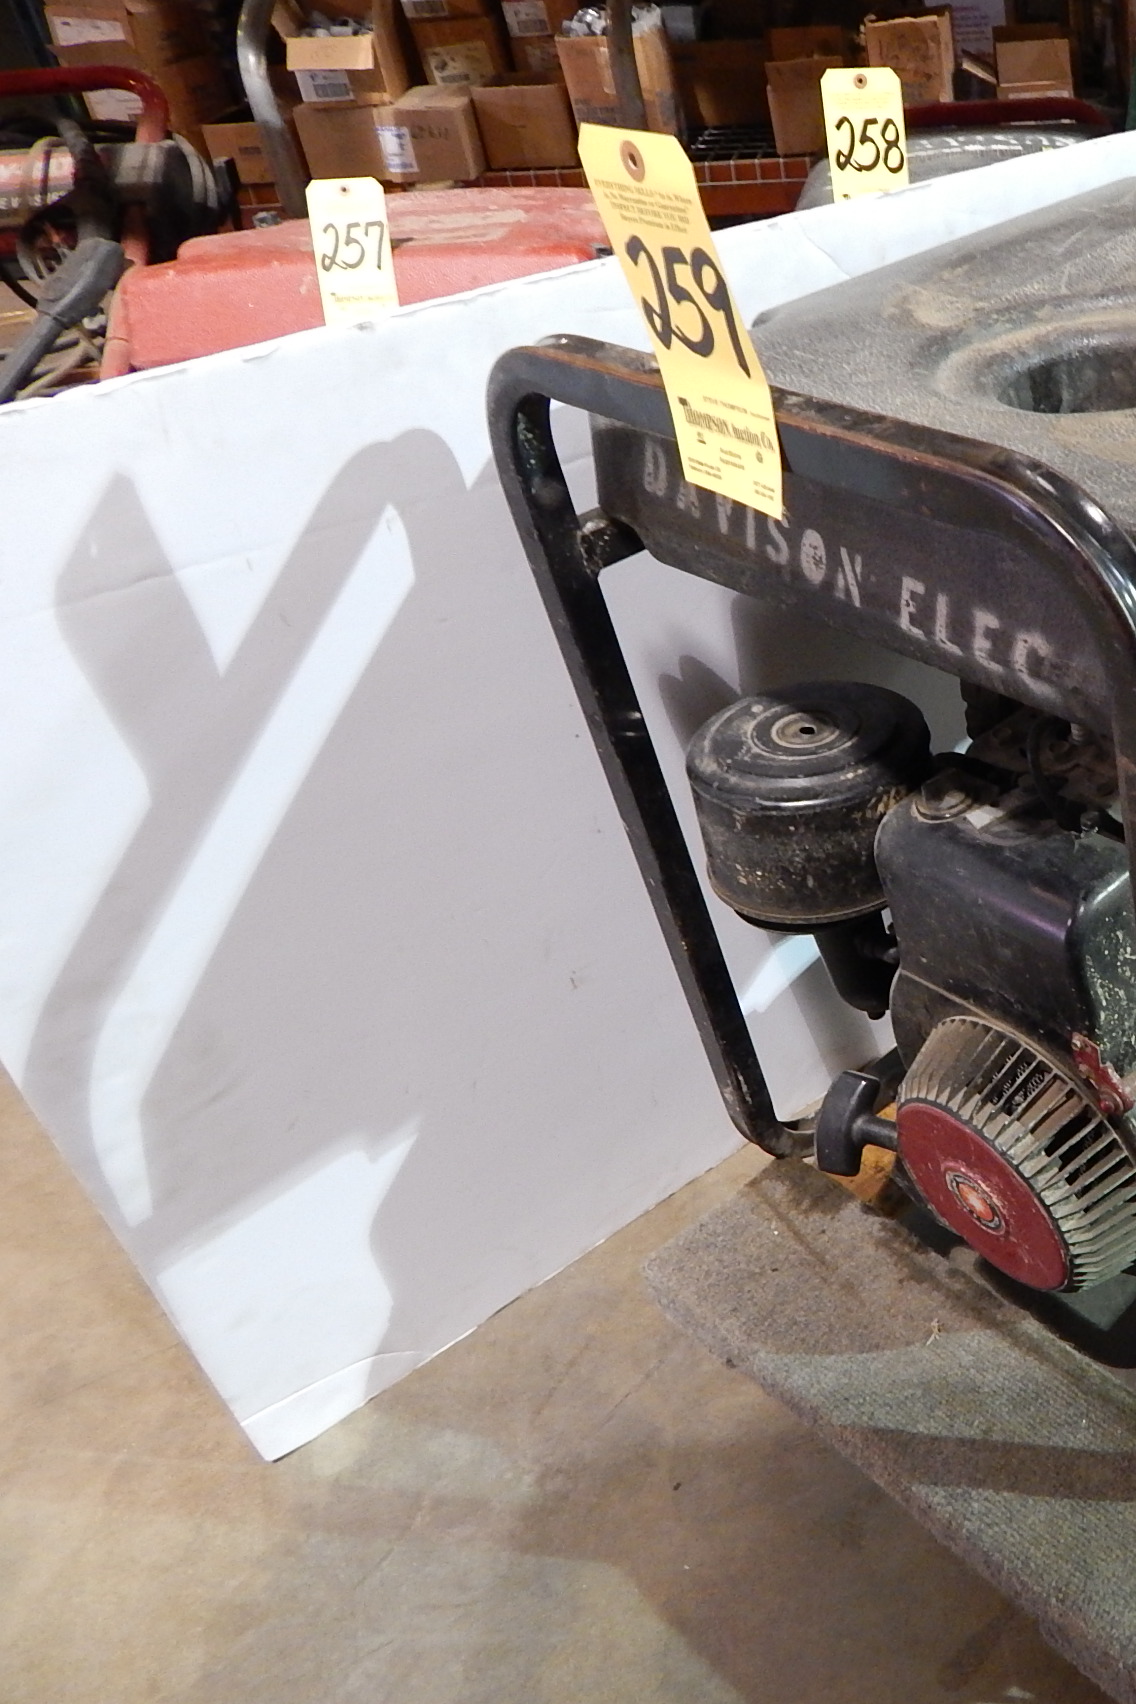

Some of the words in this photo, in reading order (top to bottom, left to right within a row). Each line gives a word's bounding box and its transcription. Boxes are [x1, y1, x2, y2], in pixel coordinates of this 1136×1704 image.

[835, 116, 905, 174] 258
[321, 220, 385, 272] 257
[625, 235, 751, 379] 259
[643, 435, 863, 608] DAVISON
